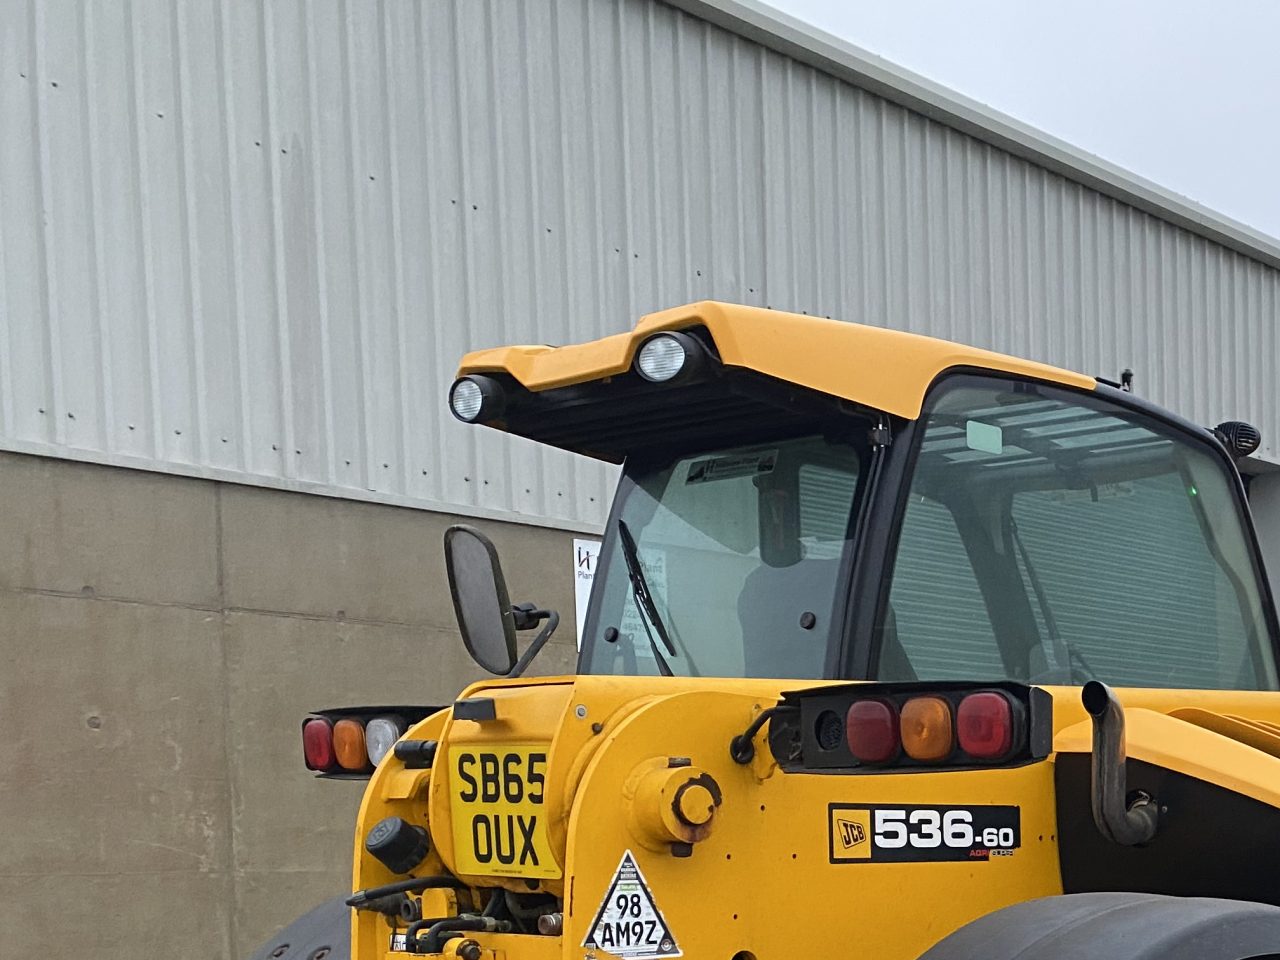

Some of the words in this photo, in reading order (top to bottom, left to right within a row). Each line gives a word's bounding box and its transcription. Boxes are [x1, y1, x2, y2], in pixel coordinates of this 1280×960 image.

[578, 570, 593, 579] Plan
[458, 752, 547, 805] SB65
[472, 813, 540, 867] OUX
[842, 822, 866, 846] JCB
[616, 893, 642, 920] 98
[601, 920, 658, 948] AM9Z
